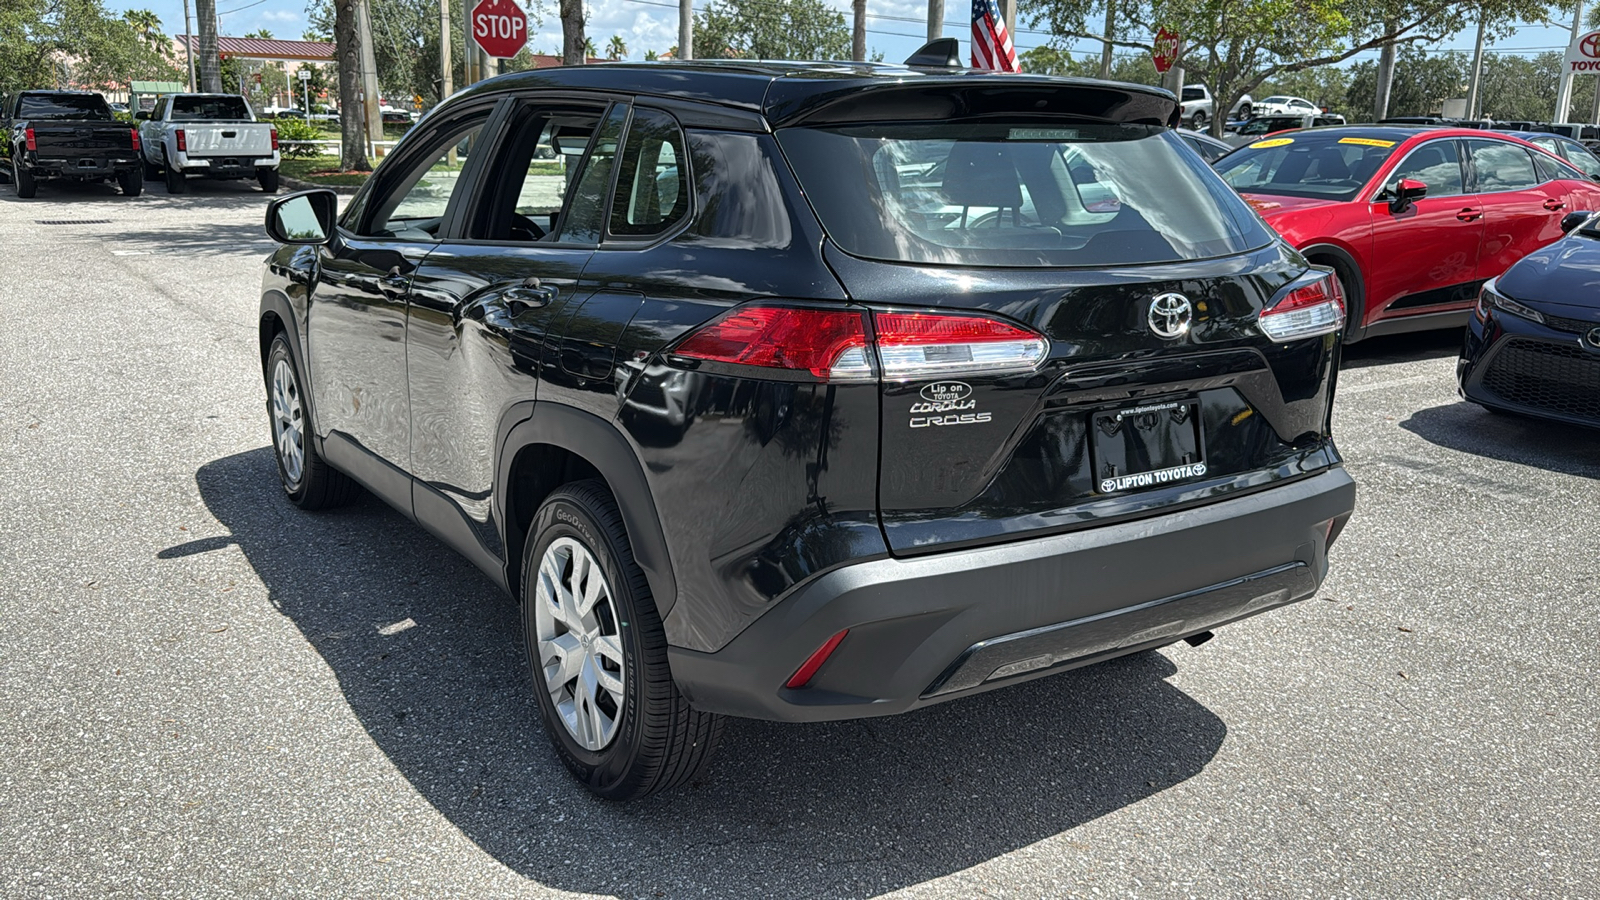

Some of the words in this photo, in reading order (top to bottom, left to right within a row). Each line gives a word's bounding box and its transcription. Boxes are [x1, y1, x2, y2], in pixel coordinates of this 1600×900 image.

[476, 14, 524, 39] STOP
[909, 400, 976, 413] COROLLA
[909, 412, 992, 428] CROSS
[1116, 474, 1153, 490] LIPTON
[1154, 466, 1193, 483] TOYOTA
[556, 508, 596, 547] GeoDrive
